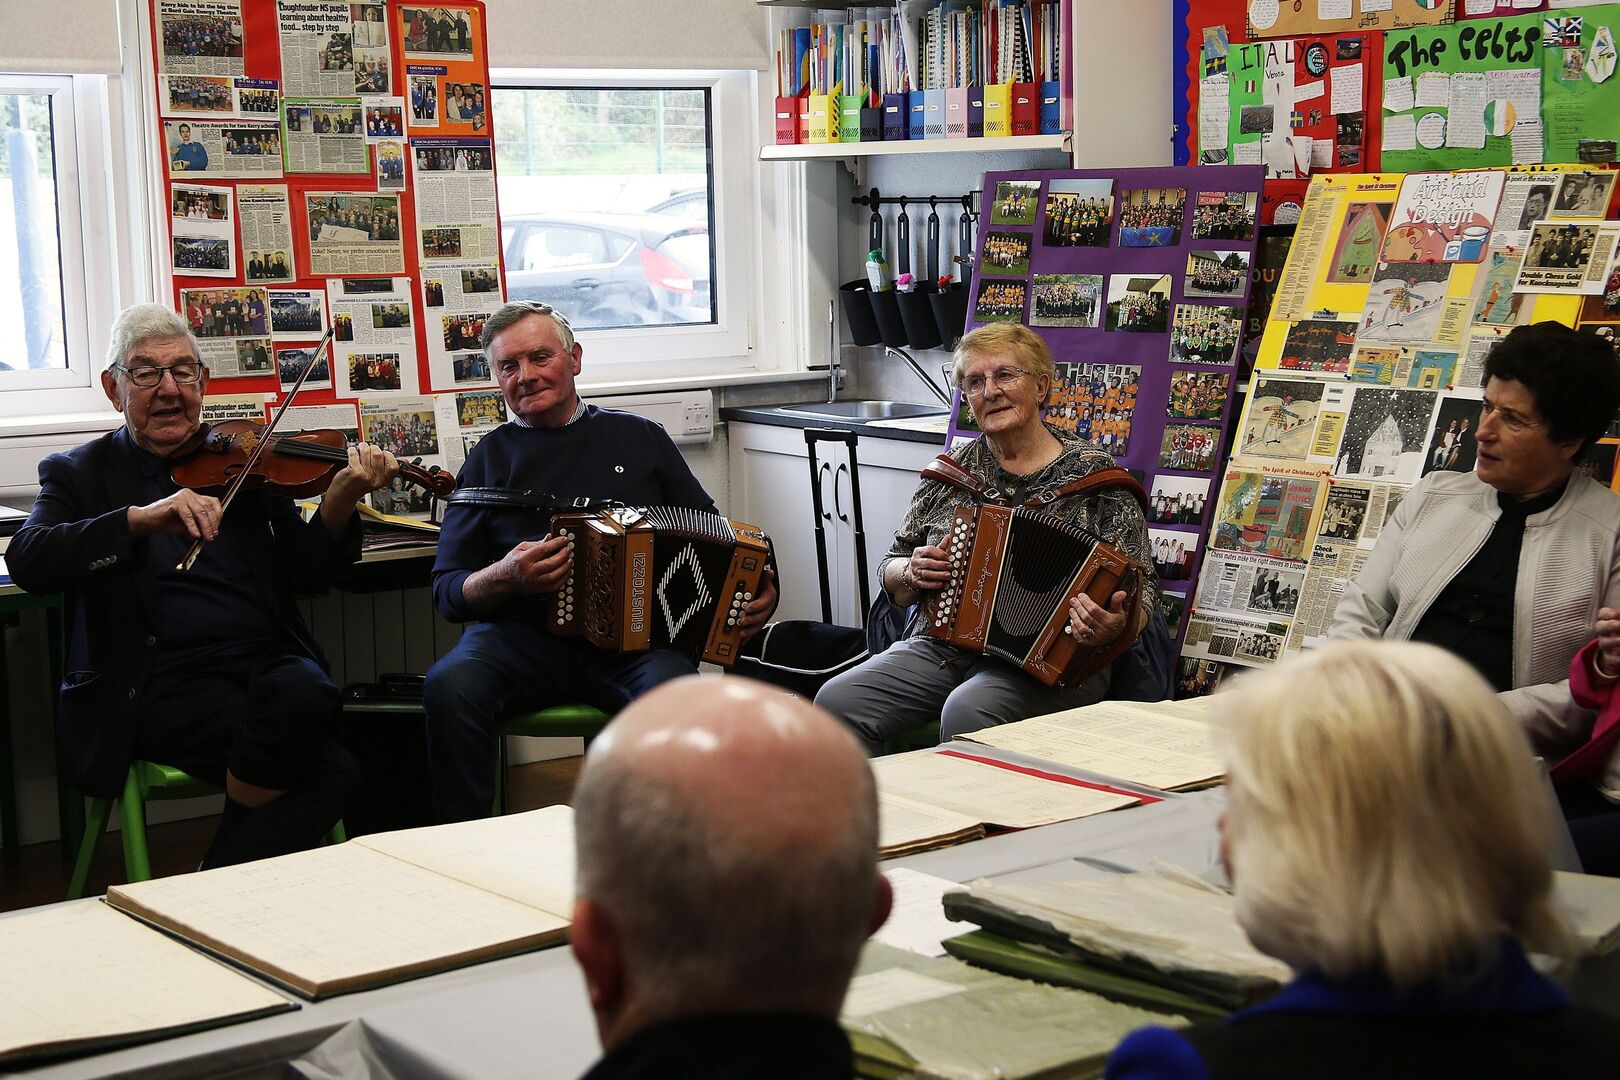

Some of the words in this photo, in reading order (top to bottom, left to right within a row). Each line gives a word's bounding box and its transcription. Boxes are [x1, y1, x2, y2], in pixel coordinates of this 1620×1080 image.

[280, 13, 306, 22] learning
[326, 14, 348, 23] healthy
[330, 4, 348, 13] pupils
[317, 24, 324, 32] by
[1240, 40, 1307, 70] ITALY
[1388, 34, 1446, 78] The
[1458, 22, 1541, 63] Celts
[1413, 179, 1446, 200] Art
[1451, 176, 1489, 199] and
[1411, 205, 1474, 229] Design
[1529, 280, 1579, 288] Knocknagoshel
[1211, 550, 1223, 559] Chess
[1257, 557, 1268, 566] right
[1290, 562, 1306, 570] Lispole
[631, 552, 646, 632] GIUSTOZZI
